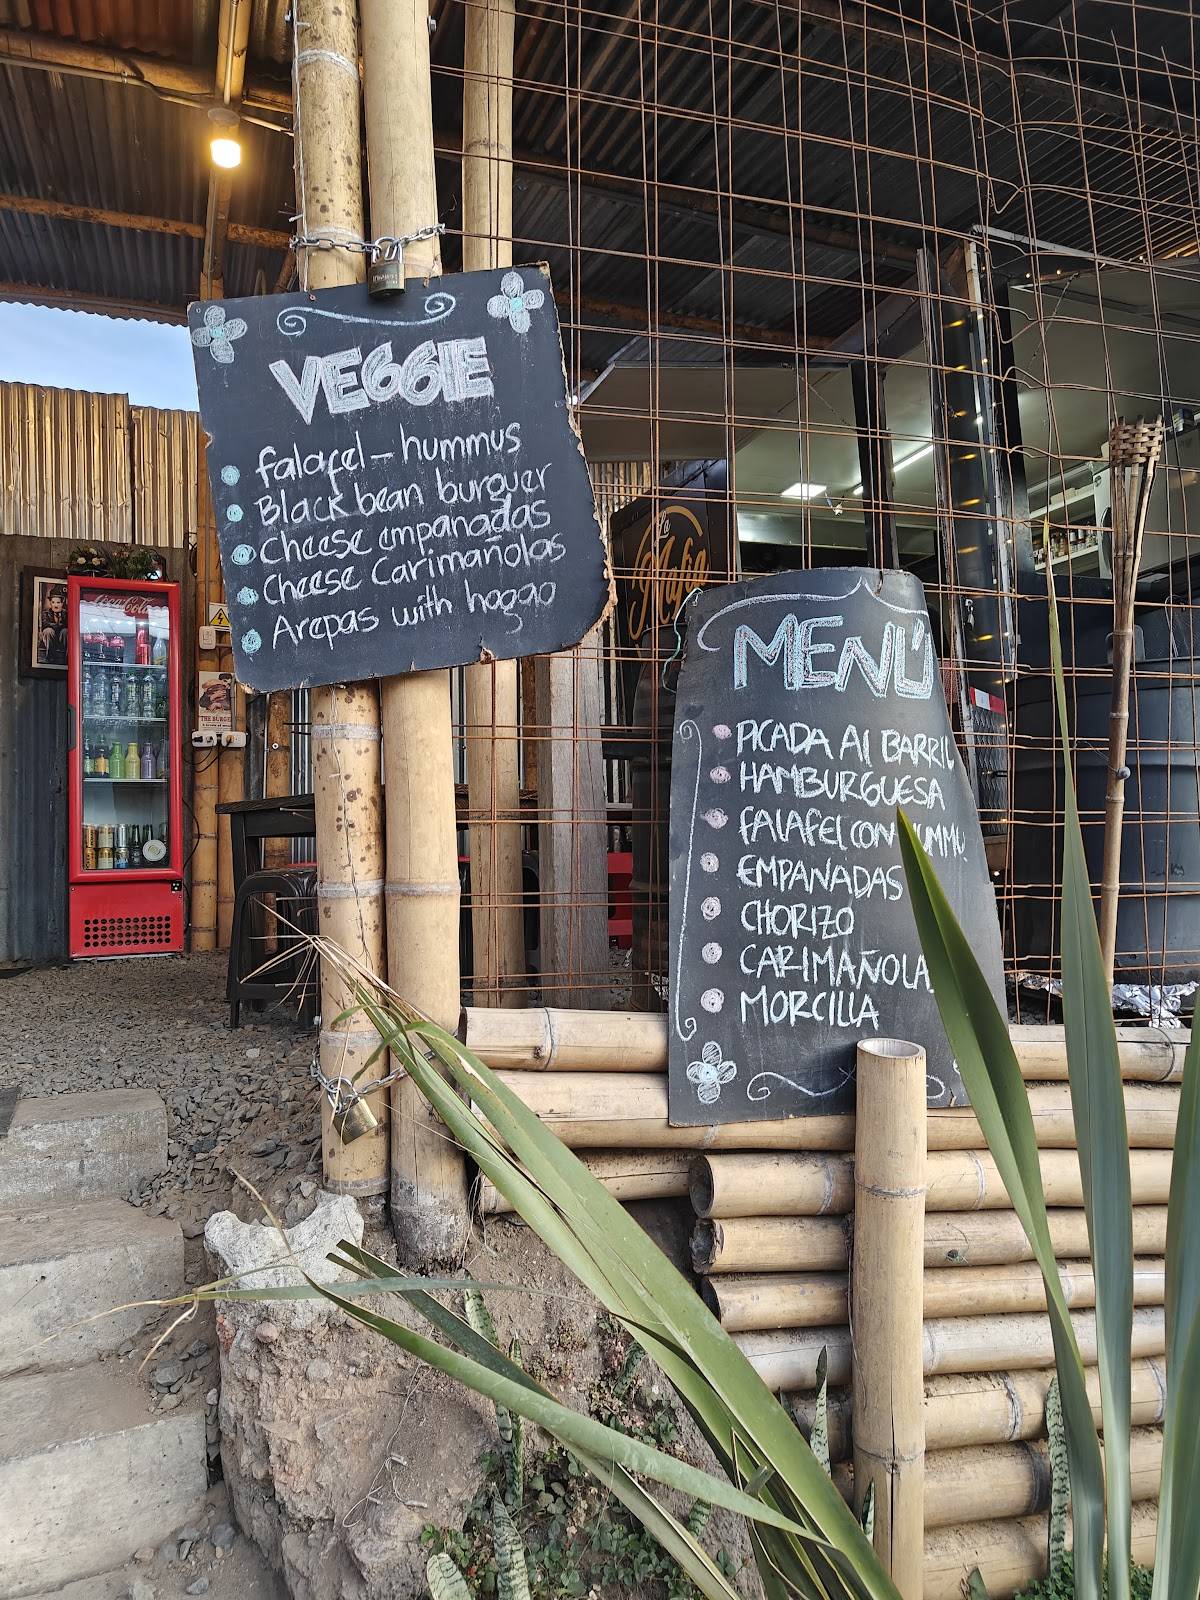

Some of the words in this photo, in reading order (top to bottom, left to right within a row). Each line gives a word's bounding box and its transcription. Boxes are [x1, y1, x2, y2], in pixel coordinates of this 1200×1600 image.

[256, 431, 366, 495] falafel
[399, 421, 522, 466] hummus
[255, 488, 350, 526] Black
[355, 482, 424, 518] bean
[436, 463, 552, 505] burguer
[260, 529, 373, 566] Cheese
[378, 493, 551, 556] empanadas
[263, 565, 363, 605] Cheese
[272, 606, 379, 650] Arepas
[391, 584, 453, 627] with
[734, 613, 934, 700] MENÚ
[736, 719, 834, 760] PICADA
[881, 728, 955, 770] BARRIL
[740, 761, 946, 811] HAMBURGUESA
[851, 820, 896, 849] CON
[736, 855, 904, 901] EMPANADAS
[740, 899, 855, 940] CHORIZO
[740, 944, 935, 993] CARIMAÑOLA
[740, 985, 880, 1031] MORCILLA
